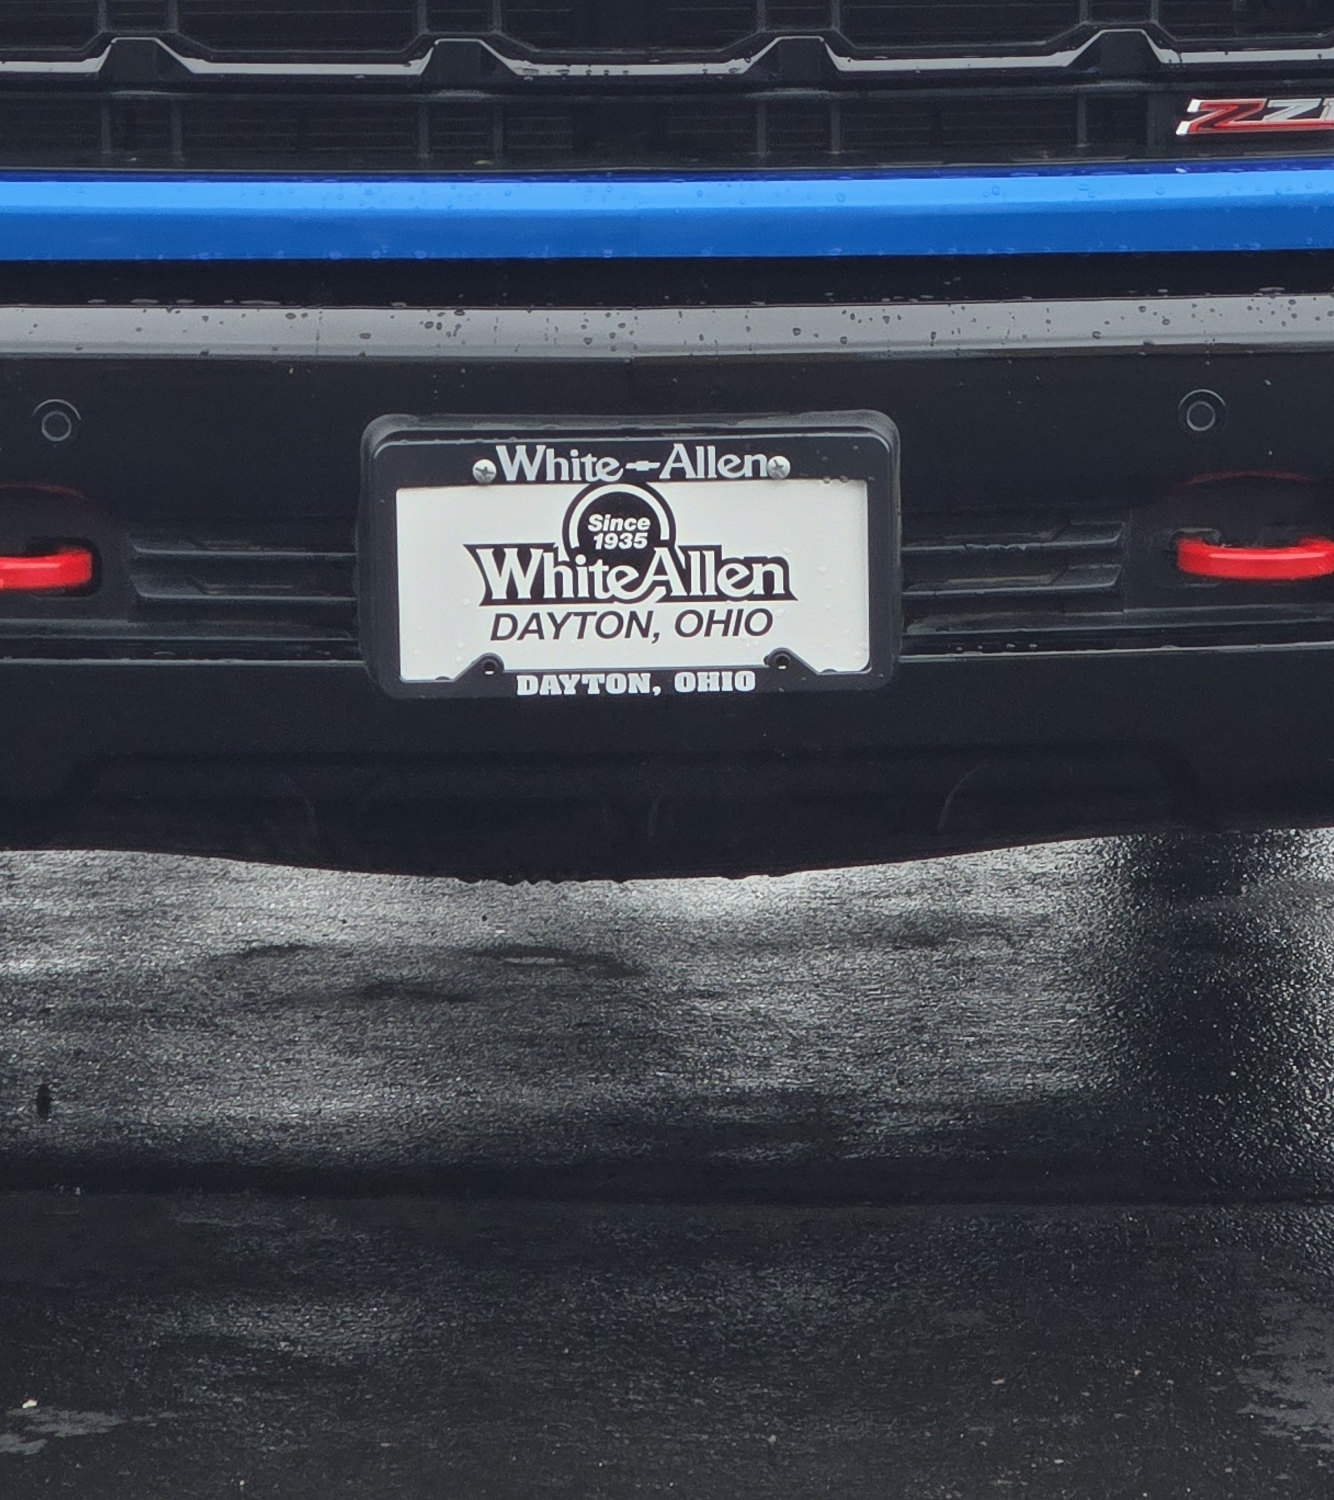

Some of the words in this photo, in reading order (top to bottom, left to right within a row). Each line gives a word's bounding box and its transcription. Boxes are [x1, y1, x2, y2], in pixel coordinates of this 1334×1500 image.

[587, 513, 651, 534] Since
[593, 533, 648, 551] 1935
[490, 610, 661, 645] DAYTON,
[674, 607, 774, 638] OHIO
[517, 671, 662, 696] DAYTON,
[674, 671, 756, 693] OHIO
